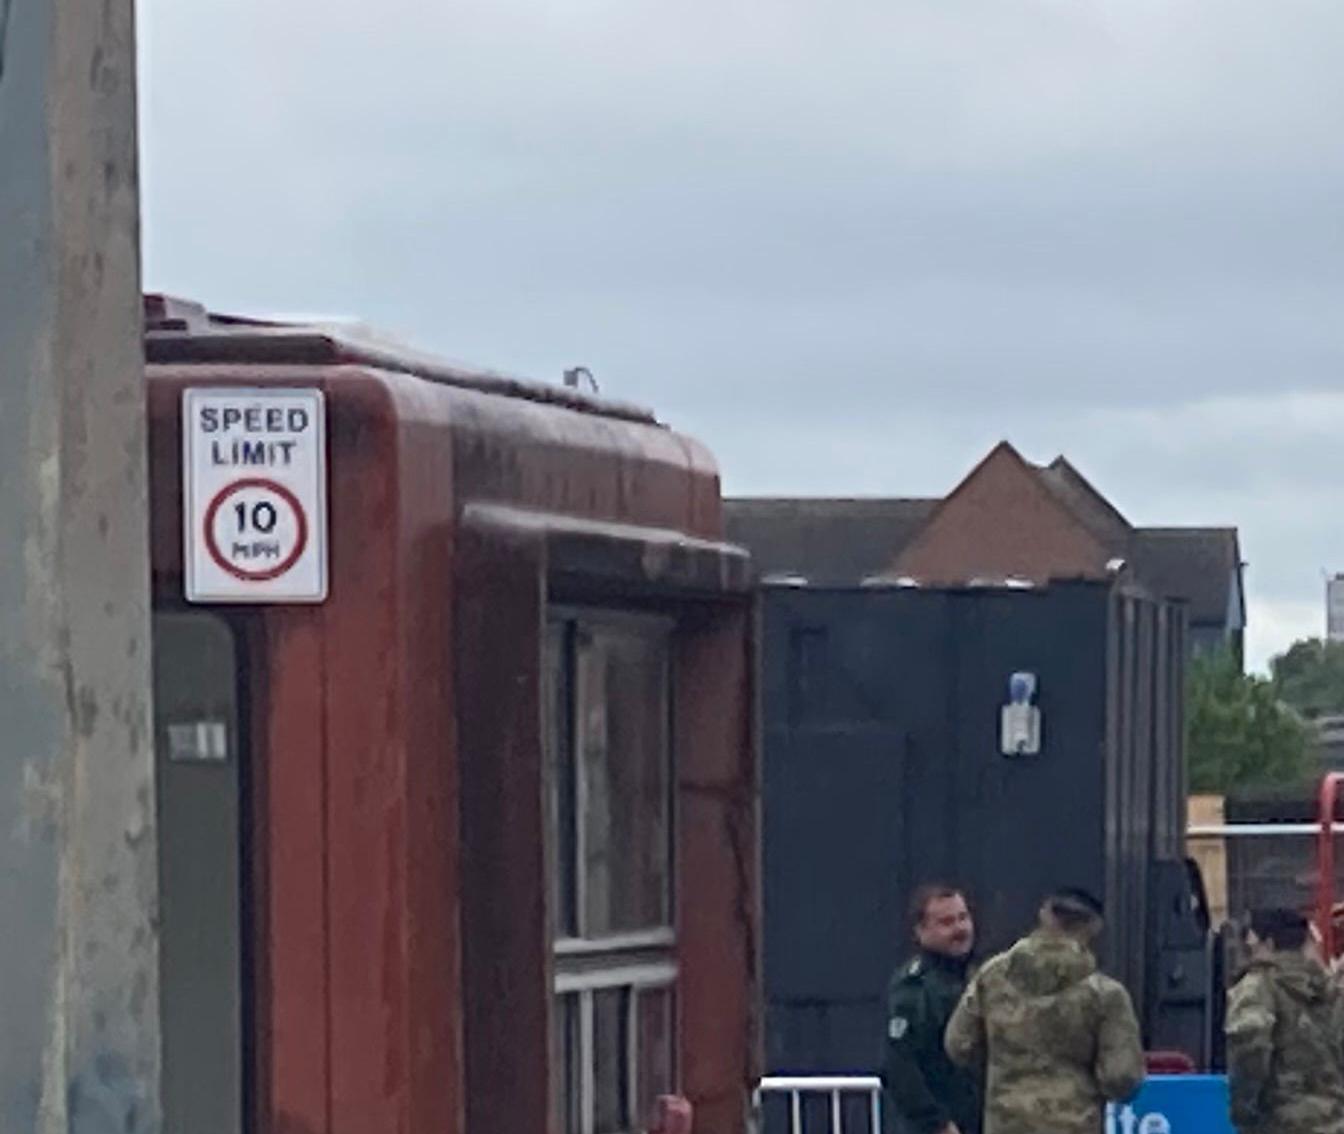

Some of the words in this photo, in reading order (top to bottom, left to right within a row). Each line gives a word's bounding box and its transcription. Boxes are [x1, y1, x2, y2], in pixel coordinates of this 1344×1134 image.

[200, 407, 309, 433] SPEED
[212, 441, 297, 467] LIMIT
[234, 501, 277, 534] 10
[231, 542, 280, 559] MPH
